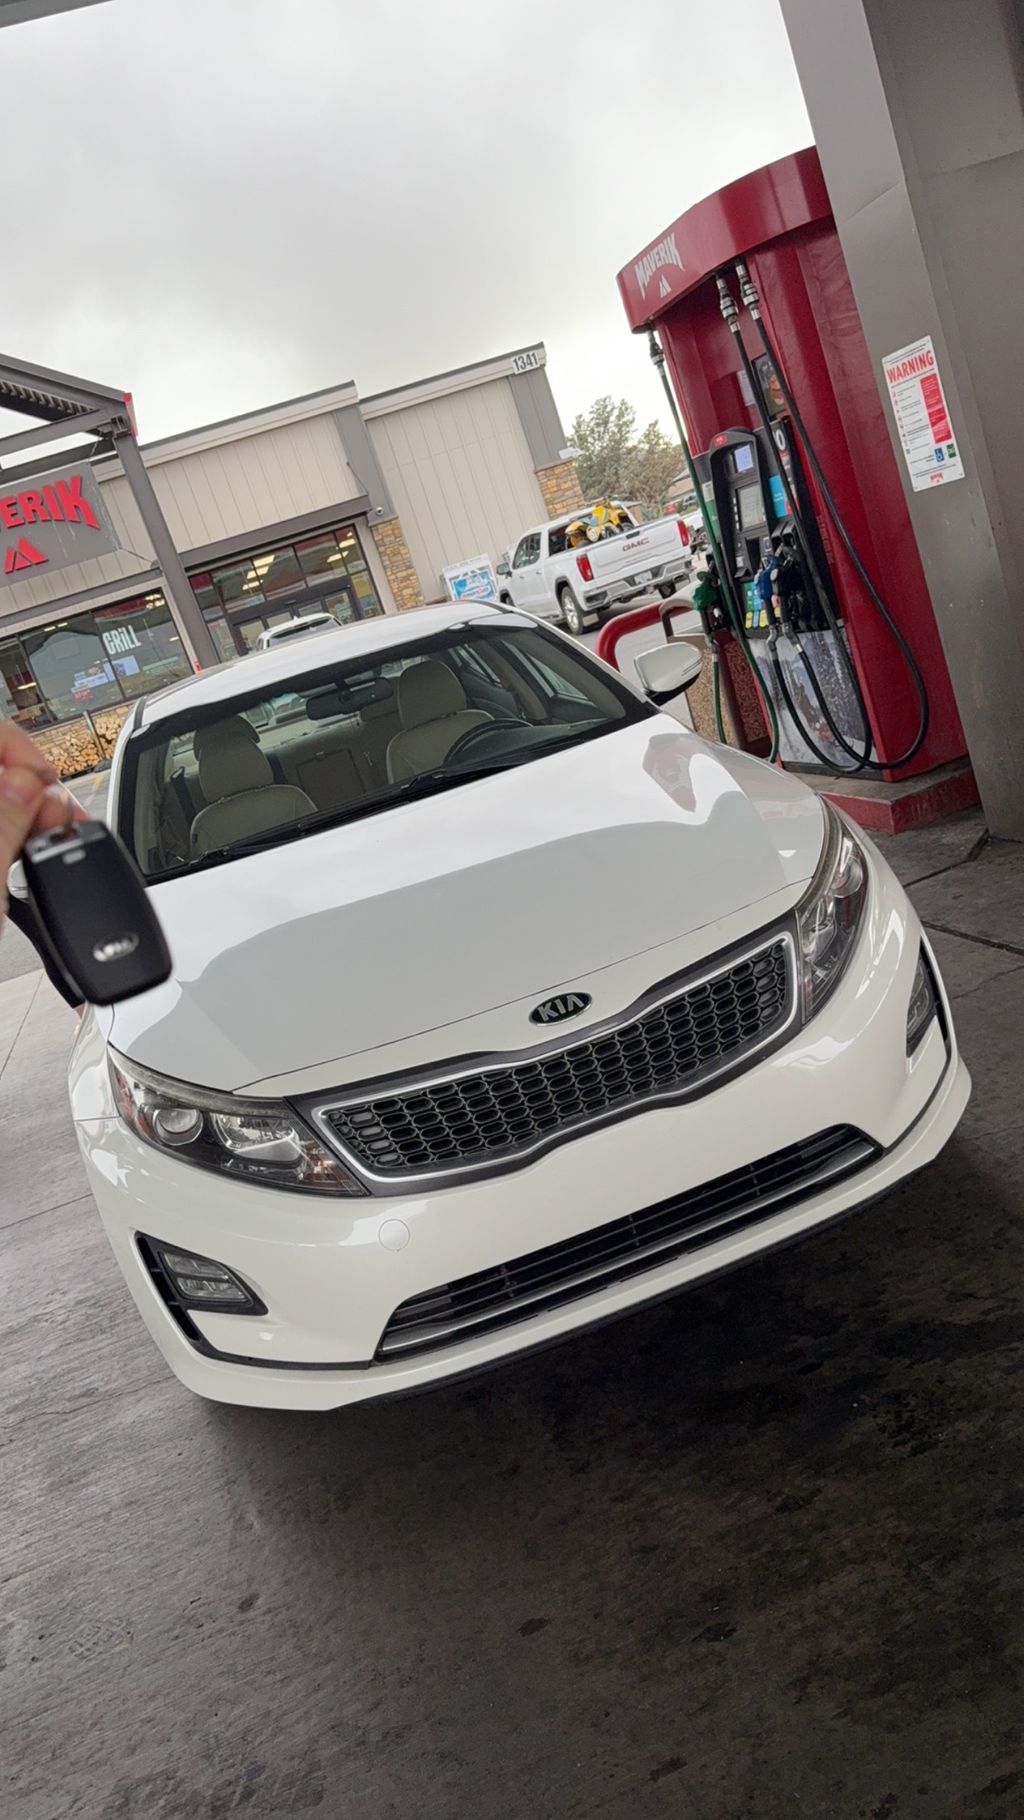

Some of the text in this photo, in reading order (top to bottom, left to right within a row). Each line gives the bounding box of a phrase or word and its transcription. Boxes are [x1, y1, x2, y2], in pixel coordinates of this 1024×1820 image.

[634, 232, 685, 302] MAVERIK
[513, 352, 538, 371] 1341
[886, 350, 935, 384] WARNING
[622, 537, 650, 552] GMC
[537, 994, 585, 1022] KIA
